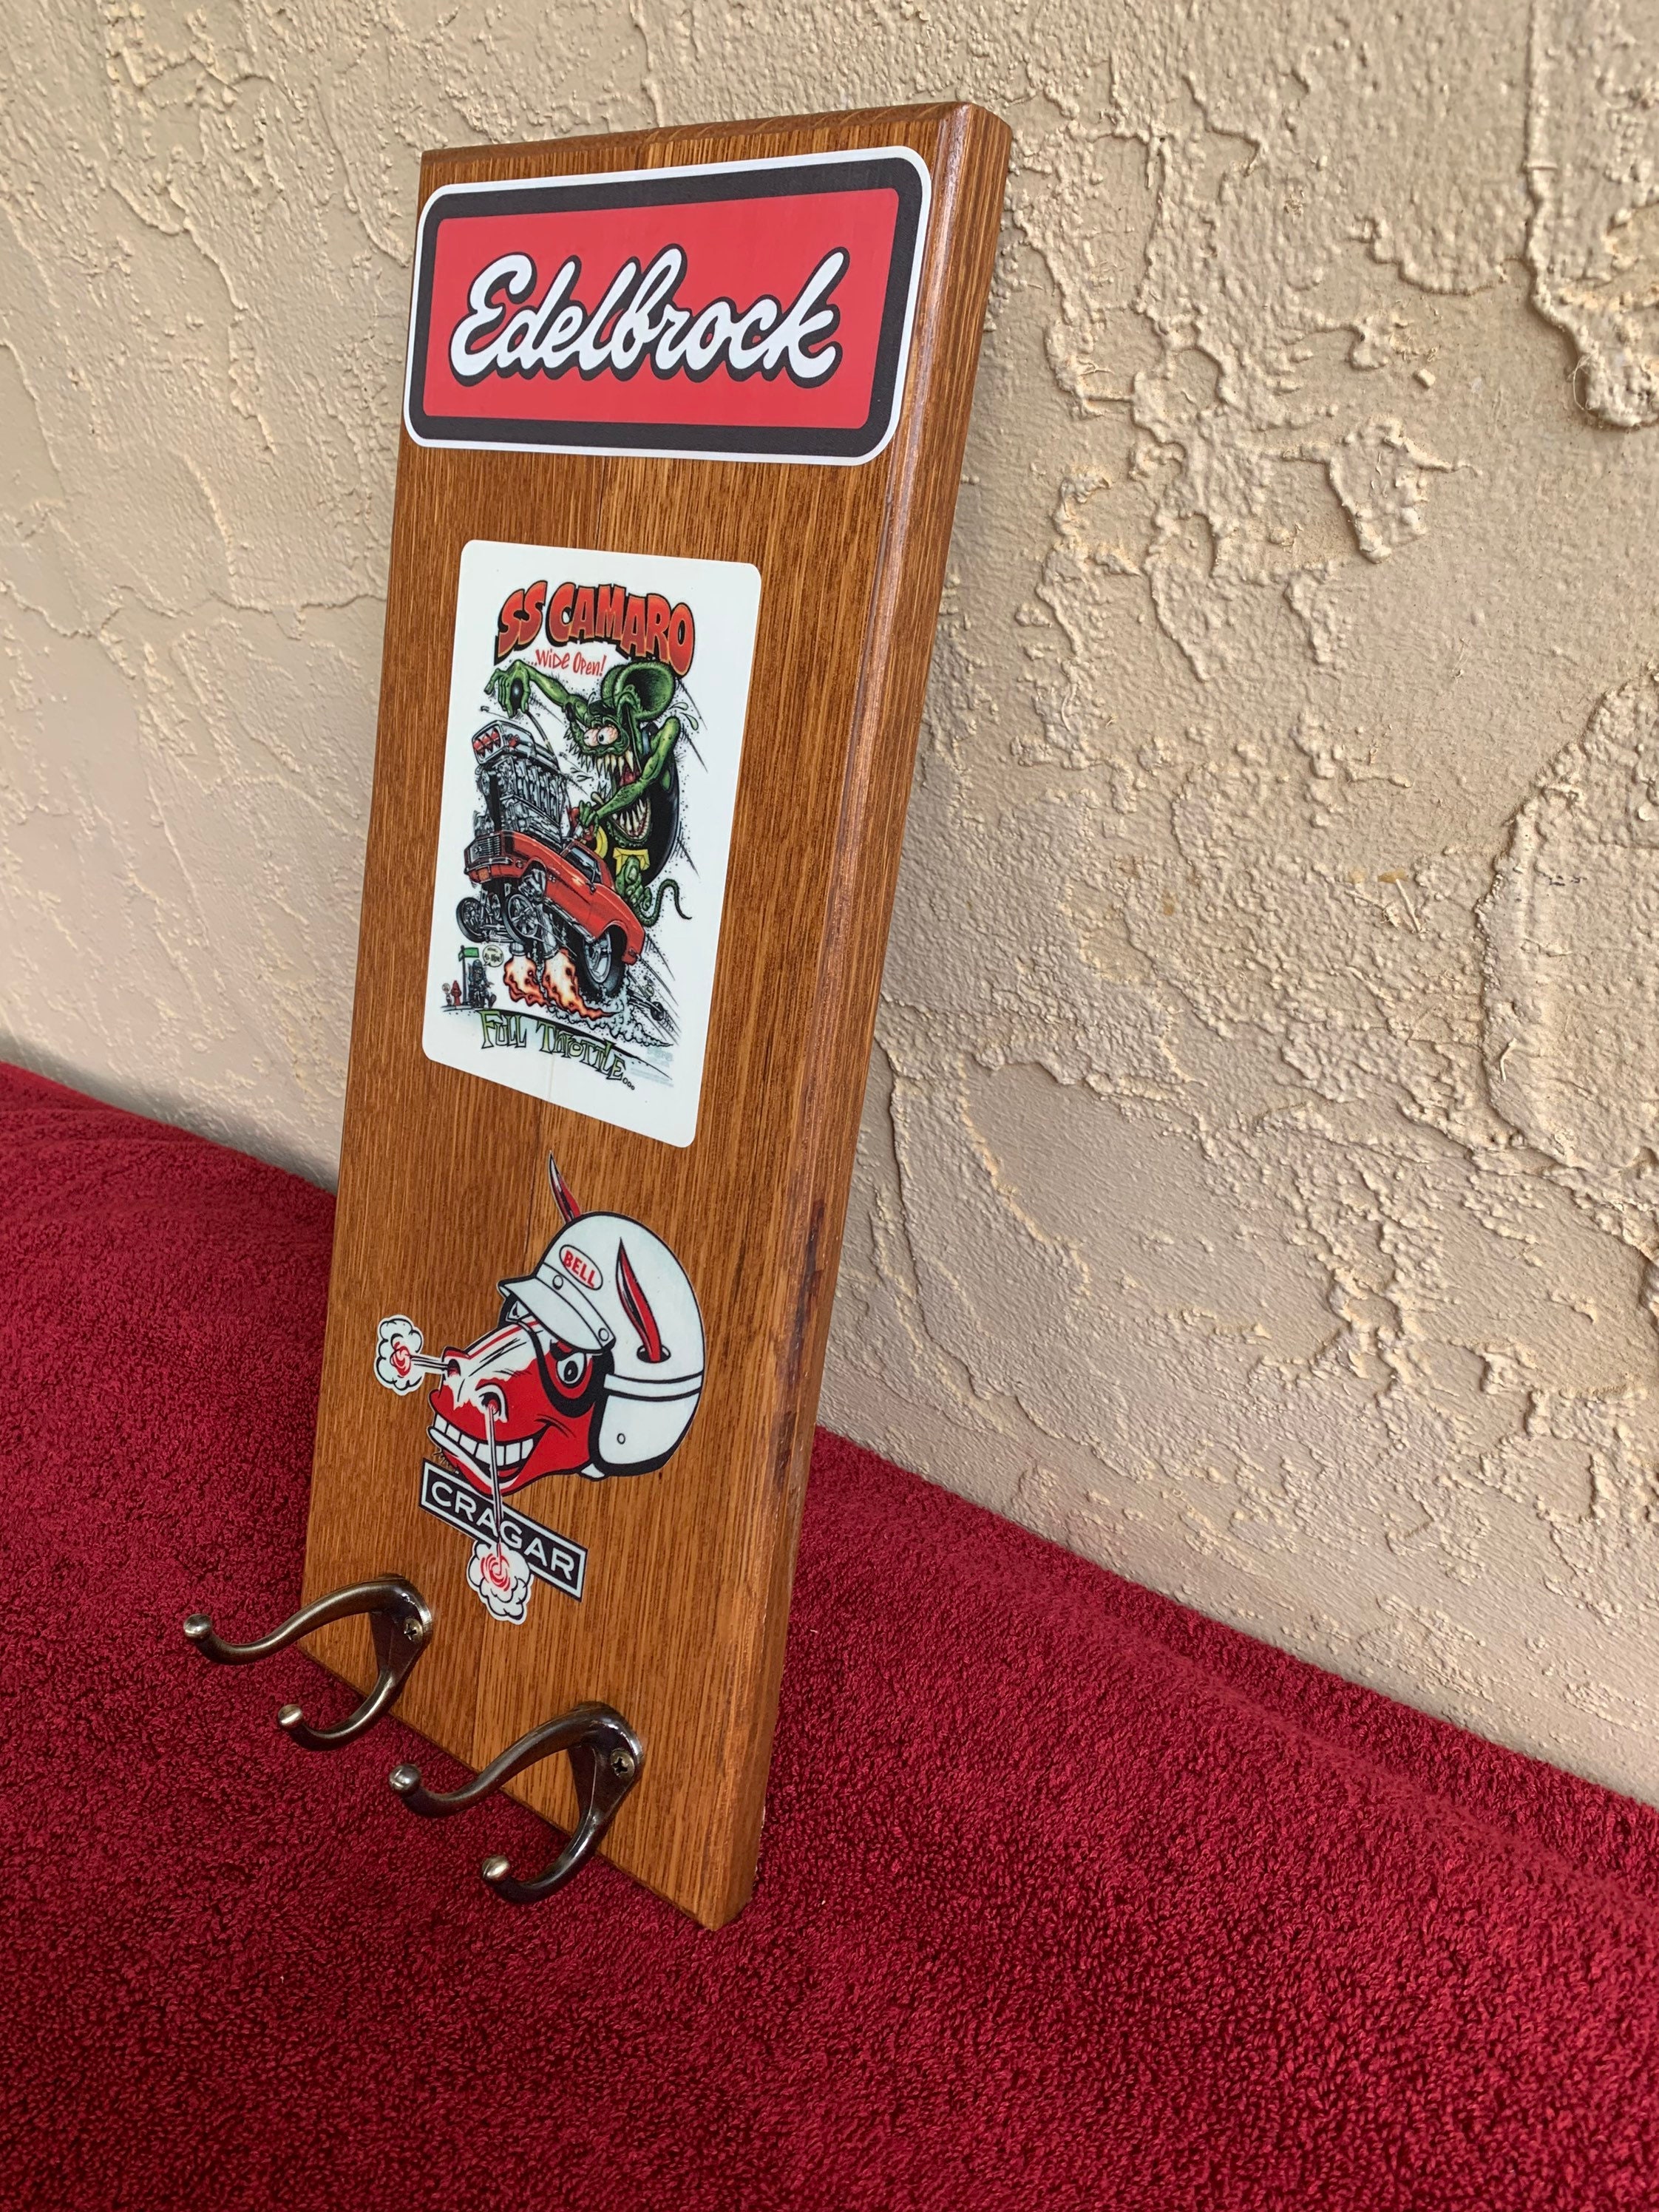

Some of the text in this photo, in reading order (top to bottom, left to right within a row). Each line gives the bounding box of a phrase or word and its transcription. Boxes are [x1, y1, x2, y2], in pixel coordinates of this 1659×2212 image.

[449, 244, 849, 387] Edelbrock
[495, 580, 695, 679] SS CAMARO
[563, 1249, 597, 1288] BELL
[431, 1481, 576, 1581] CRAGAR
